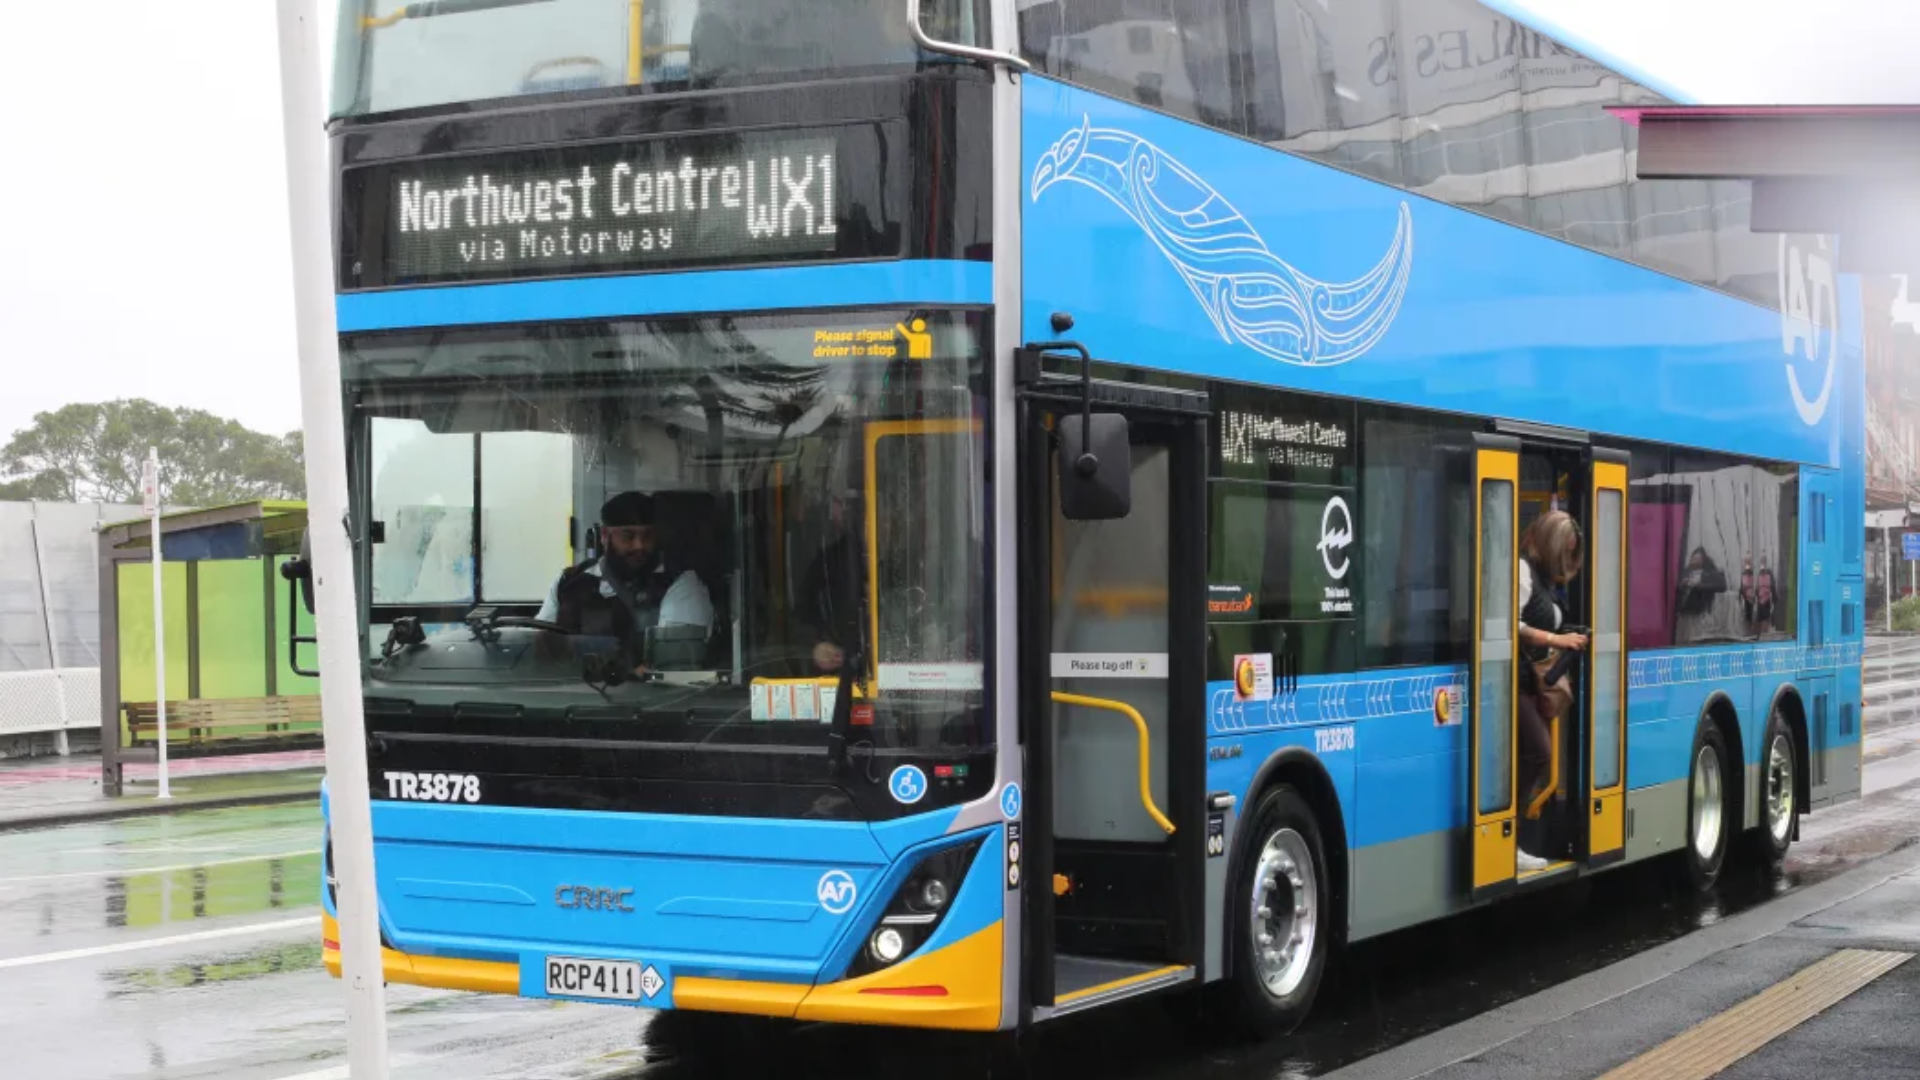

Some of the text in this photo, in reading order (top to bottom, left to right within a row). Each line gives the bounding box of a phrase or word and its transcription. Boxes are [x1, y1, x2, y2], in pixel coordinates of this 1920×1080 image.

[400, 157, 741, 232] Northwest Centre
[748, 155, 836, 238] WX1
[460, 227, 672, 262] via Motorway
[814, 329, 894, 343] Please signal
[813, 344, 897, 357] driver to stop
[1221, 411, 1253, 463] WX1
[1254, 415, 1310, 443] Northwest
[1071, 660, 1132, 672] Please tag off
[1315, 726, 1355, 752] TR3878
[383, 771, 481, 802] TR3878
[555, 884, 635, 912] CRRC
[820, 881, 851, 902] AT
[549, 962, 634, 994] RCP411
[643, 977, 658, 988] EV
